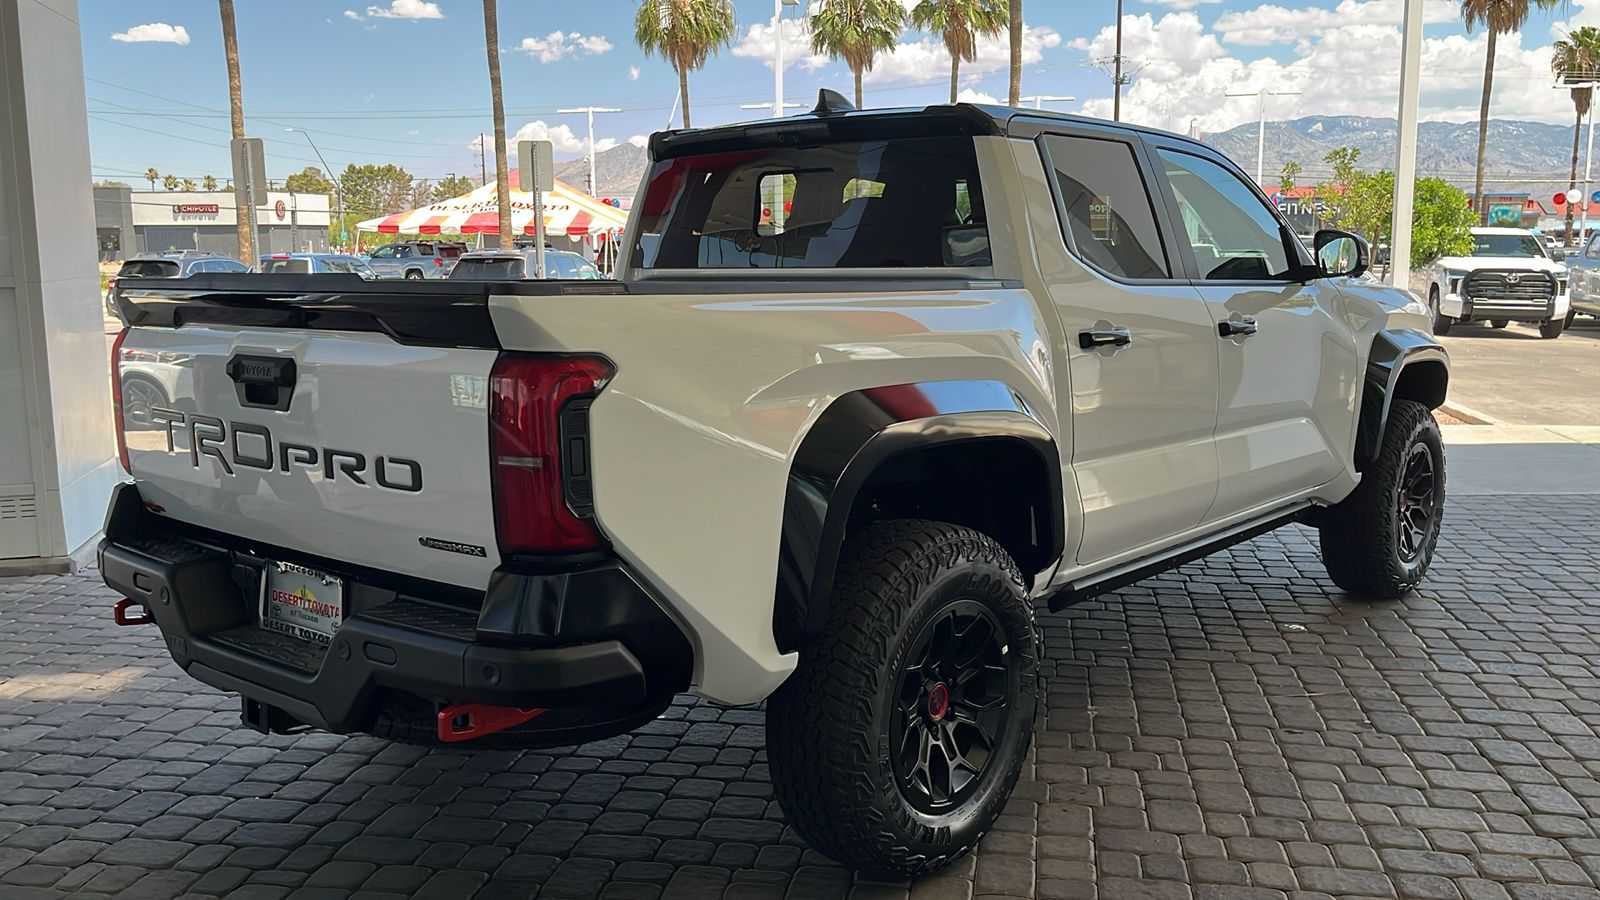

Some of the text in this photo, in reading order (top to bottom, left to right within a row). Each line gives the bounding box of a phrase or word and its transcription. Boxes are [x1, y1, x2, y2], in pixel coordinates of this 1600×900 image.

[181, 205, 218, 213] CHIPOTLE
[509, 201, 569, 211] OYOTA
[151, 407, 423, 493] TRD PRO
[283, 563, 321, 578] TUCSON
[272, 589, 340, 618] DESERT TOYOTA
[297, 611, 319, 623] Tucson
[263, 619, 296, 635] DESERT
